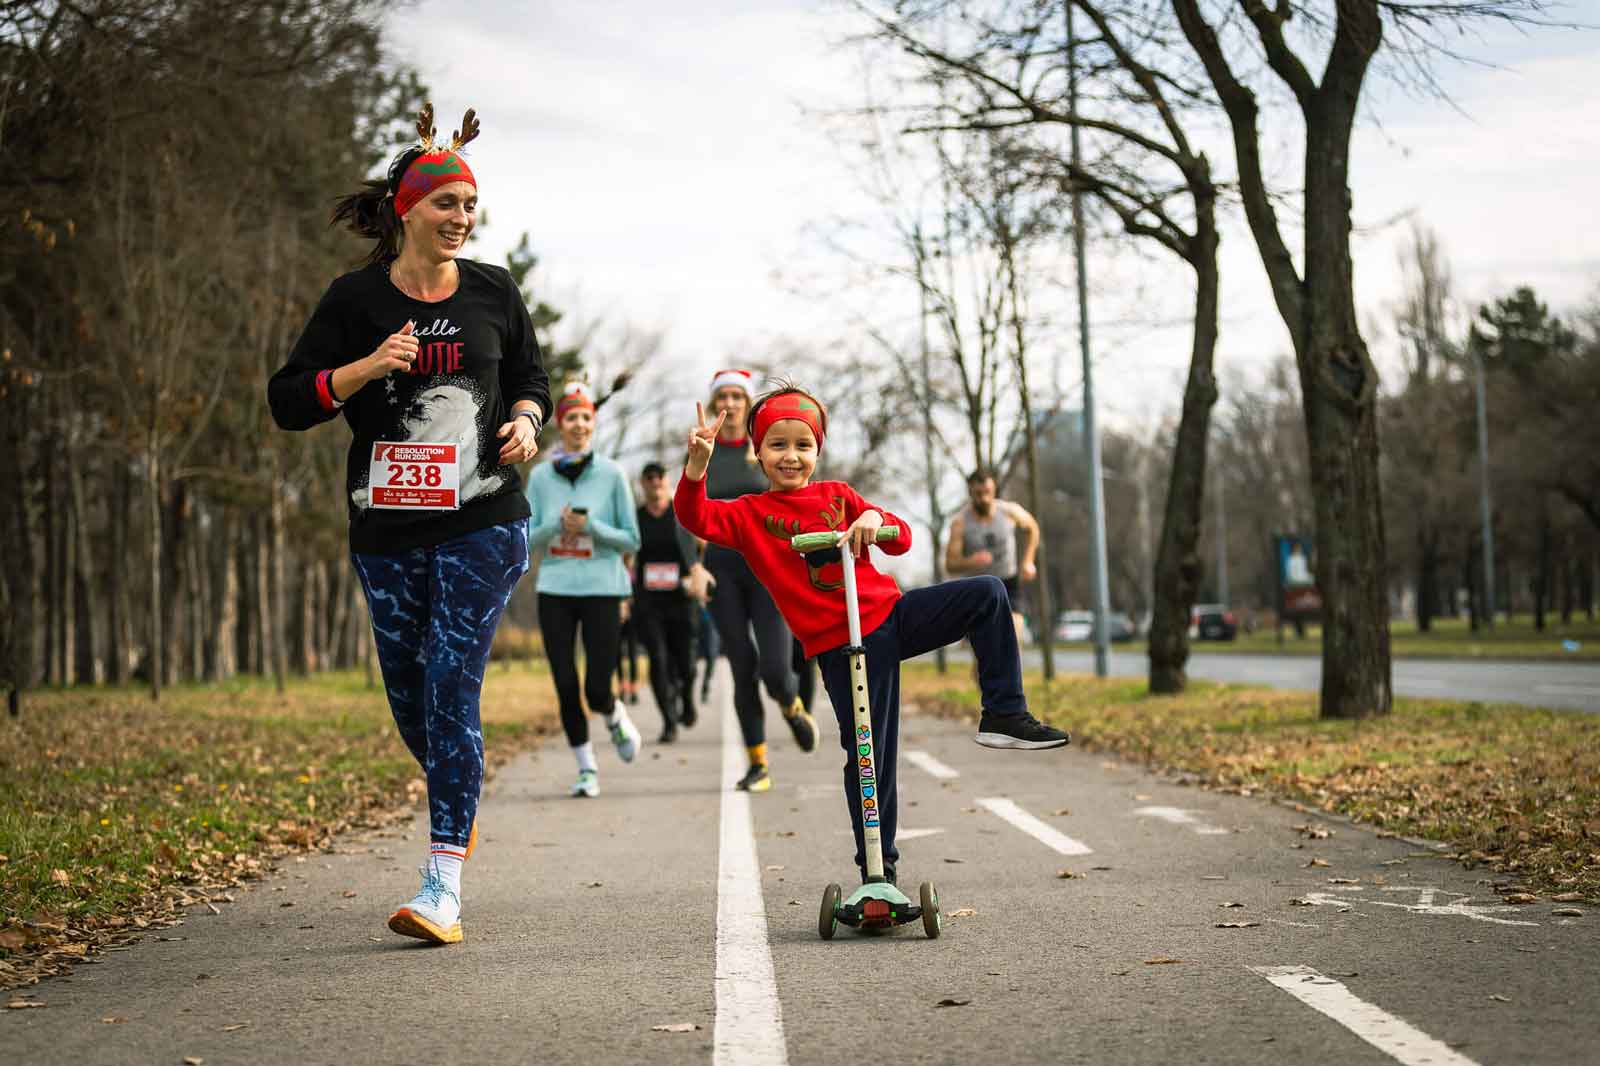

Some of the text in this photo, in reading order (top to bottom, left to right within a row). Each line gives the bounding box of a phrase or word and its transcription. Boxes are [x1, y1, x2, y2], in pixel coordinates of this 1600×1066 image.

[410, 318, 462, 337] hello
[409, 341, 465, 376] UTIE
[394, 447, 445, 455] RESOLUTION
[394, 453, 412, 461] RUN
[387, 463, 442, 487] 238
